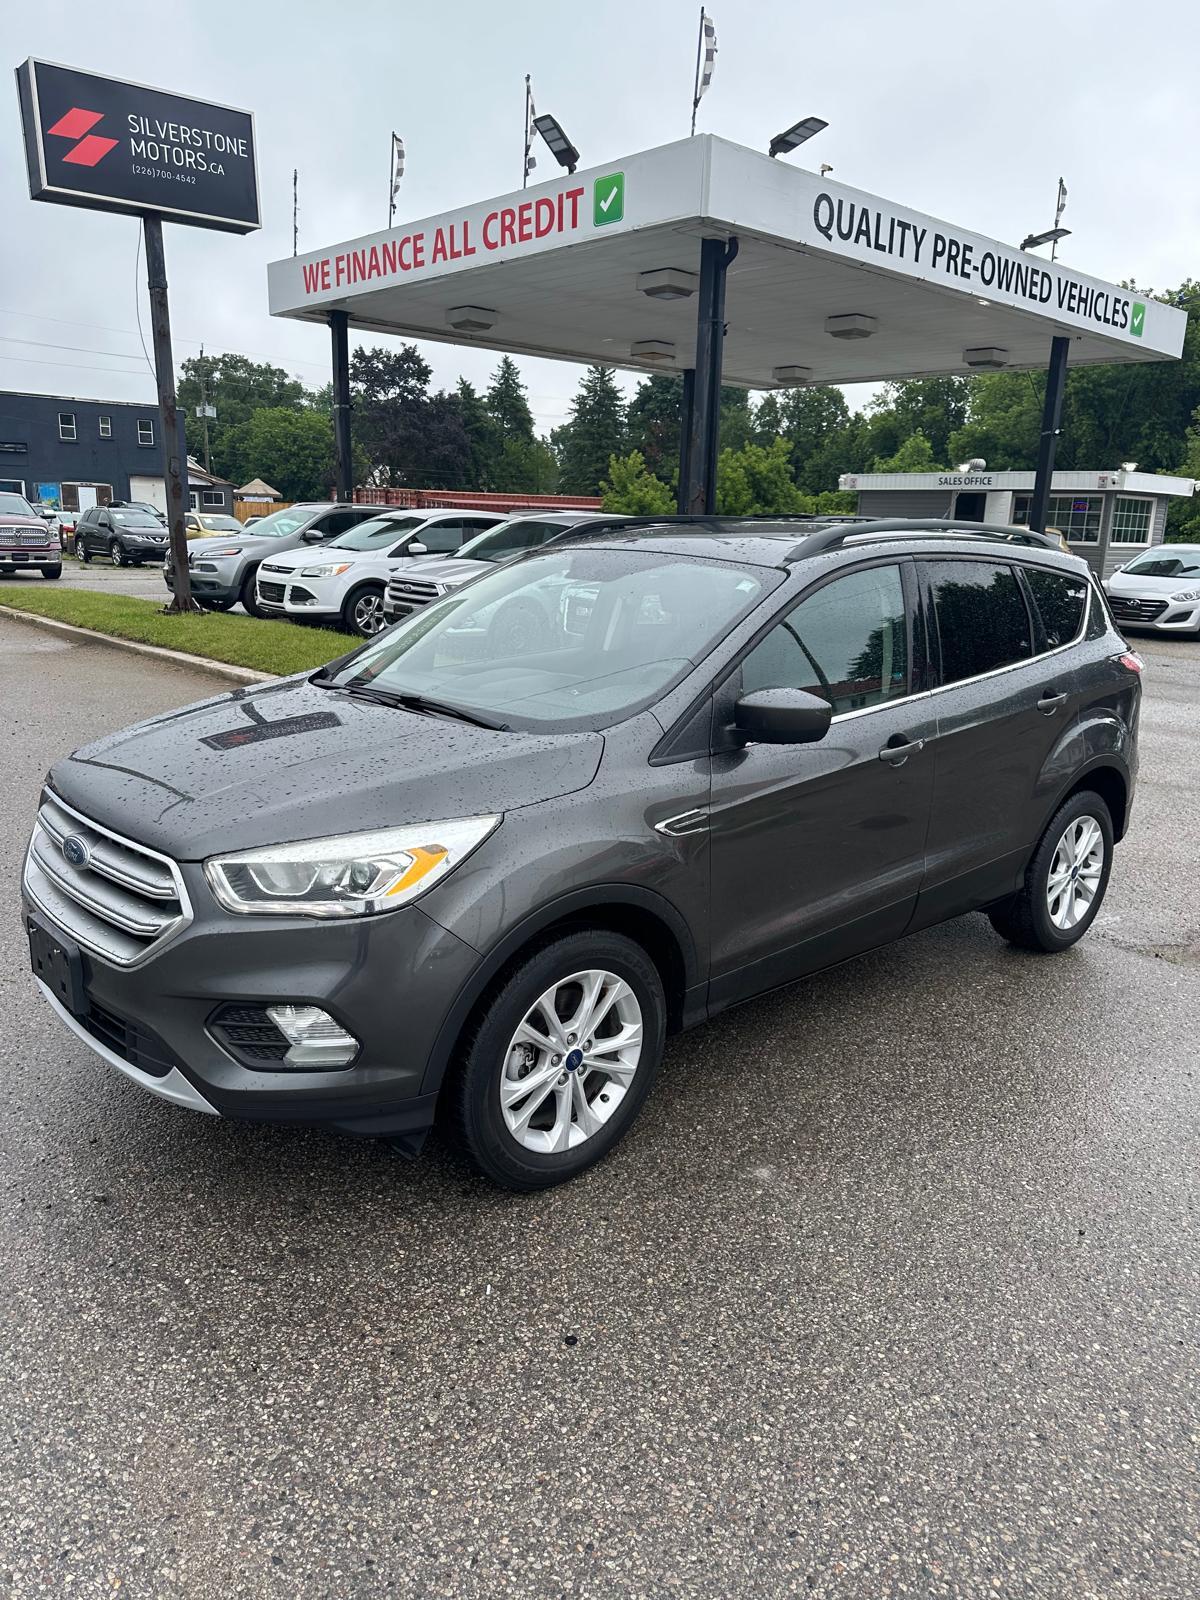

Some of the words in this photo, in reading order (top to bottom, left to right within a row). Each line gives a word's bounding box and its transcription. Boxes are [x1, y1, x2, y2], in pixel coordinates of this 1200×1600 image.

[128, 114, 248, 158] SILVERSTONE
[132, 164, 196, 184] (226)700-4542
[303, 259, 331, 294] WE
[336, 233, 425, 286] FINANCE
[432, 221, 476, 264] ALL
[482, 187, 584, 250] CREDIT
[814, 193, 927, 262] QUALITY
[932, 233, 1052, 304] PRE-OWNED
[1057, 277, 1129, 330] VEHICLES
[938, 476, 963, 486] SALES
[963, 476, 993, 486] OFFICE
